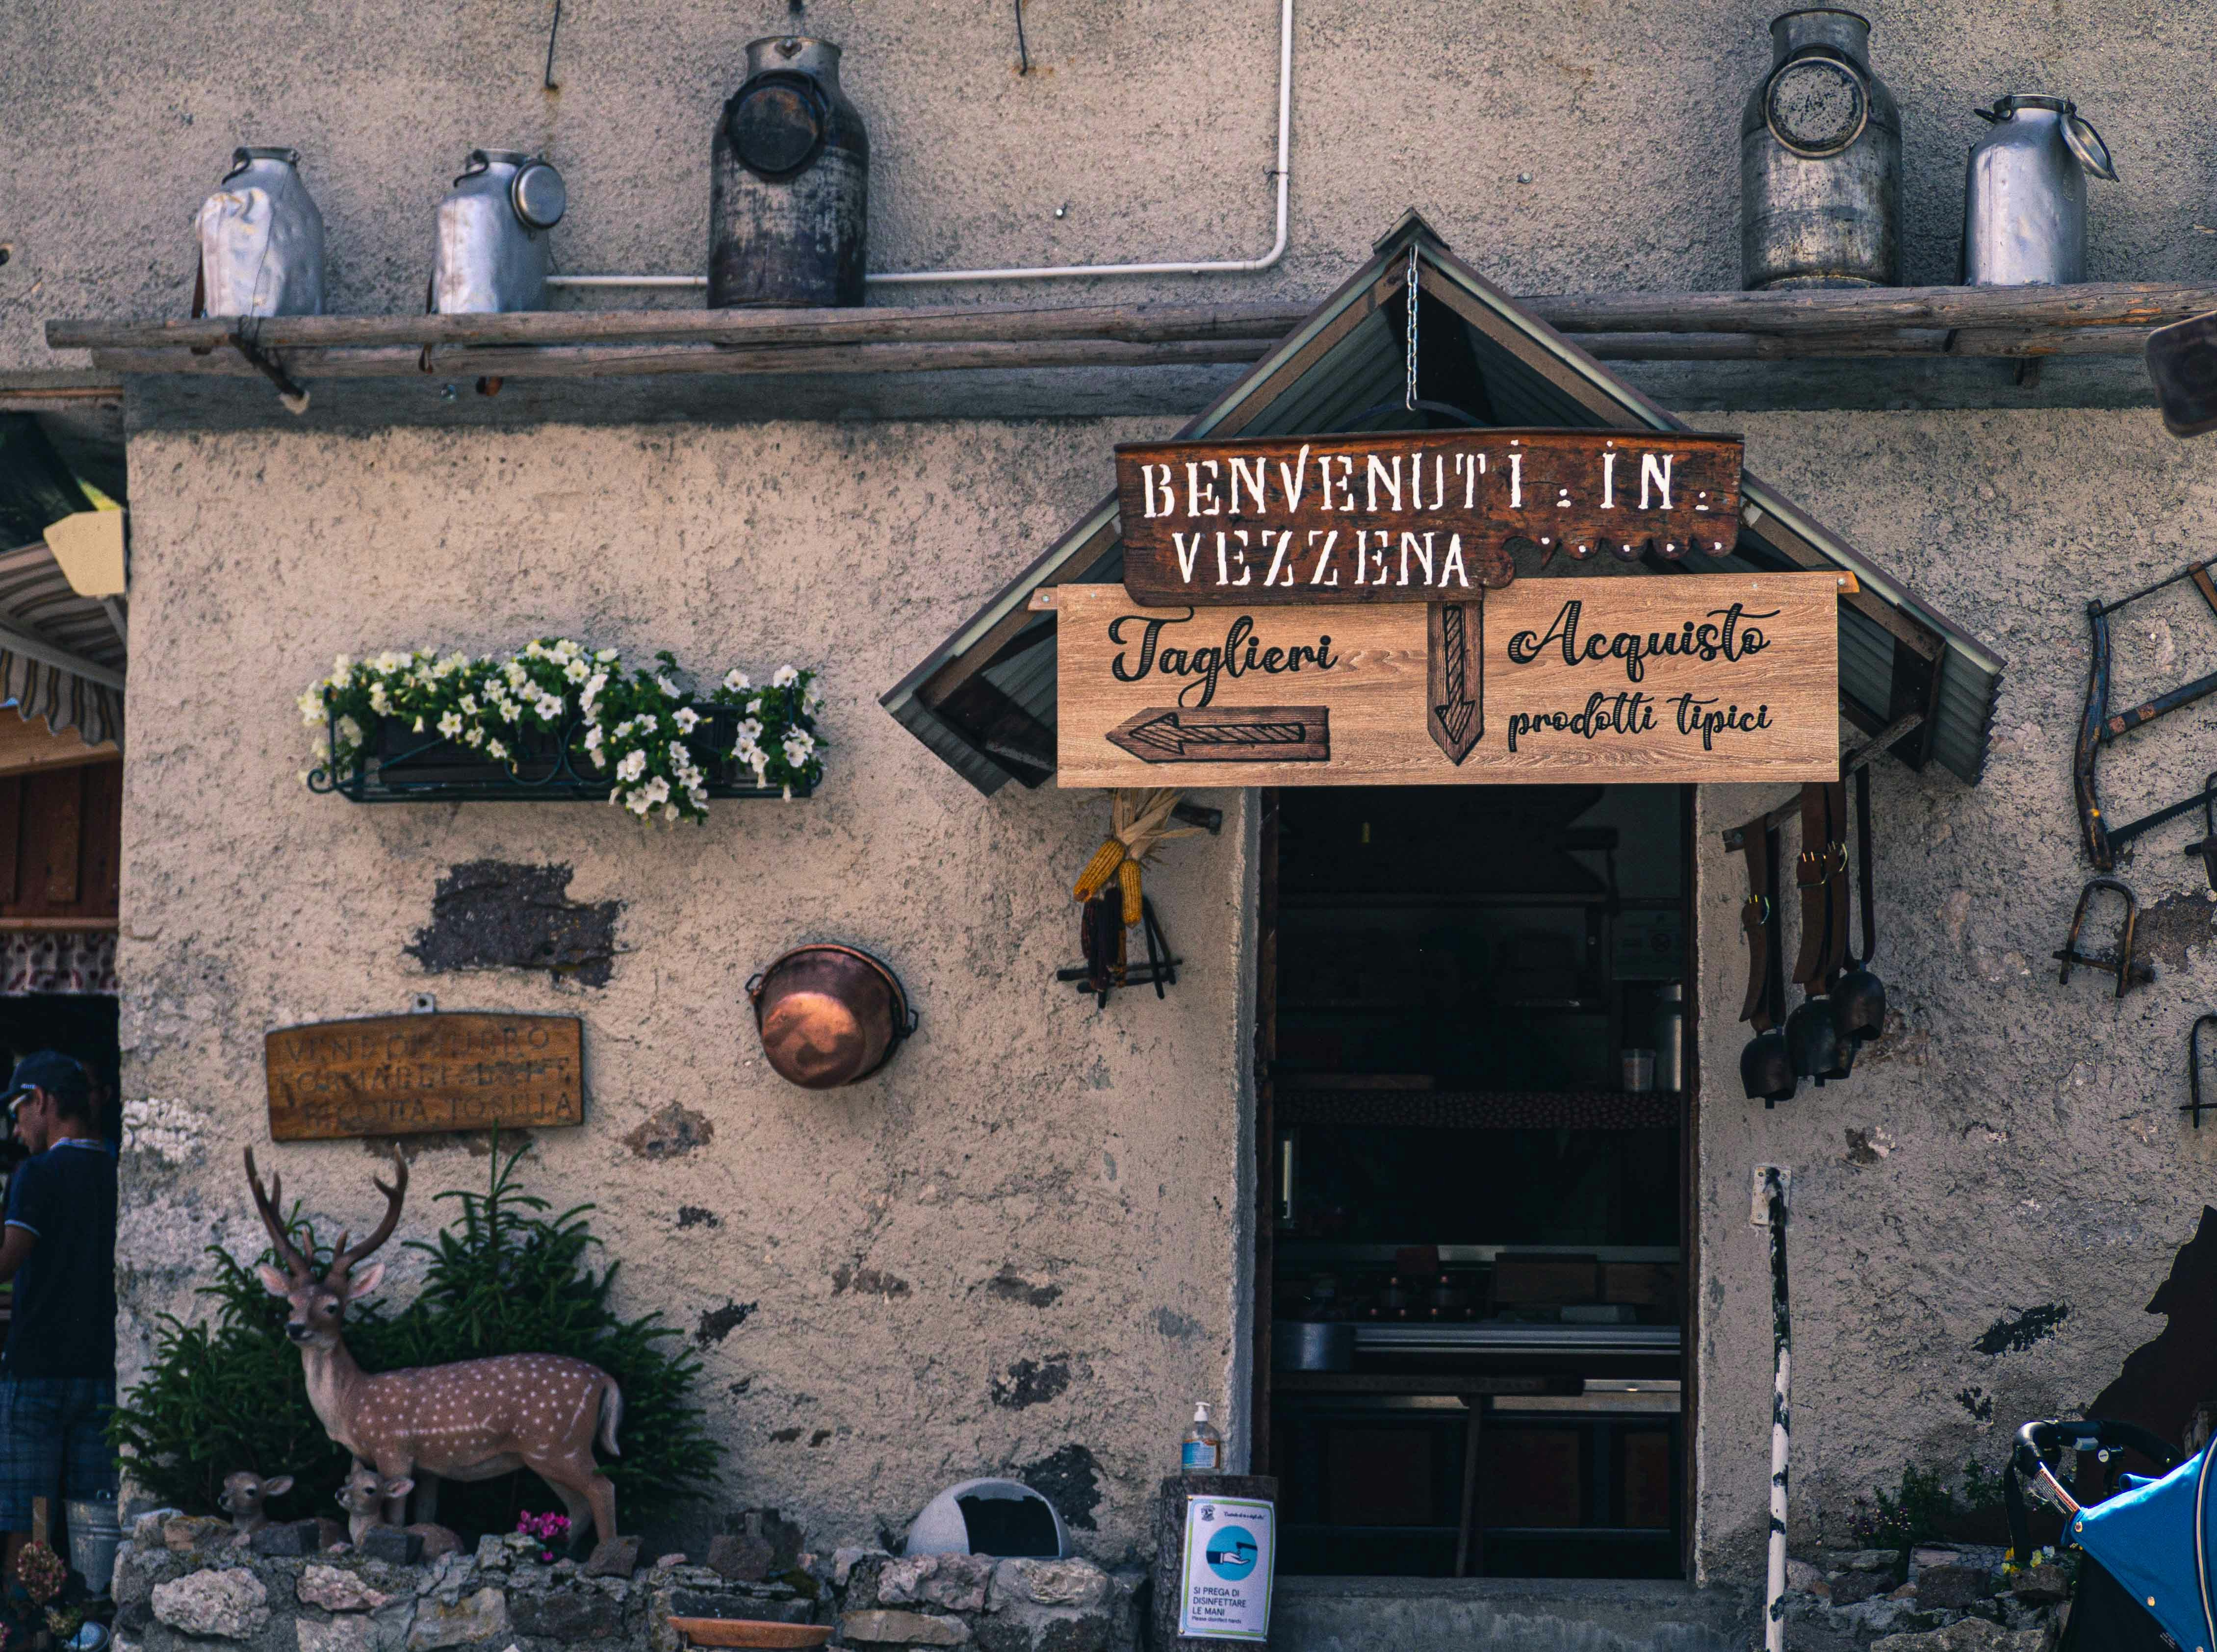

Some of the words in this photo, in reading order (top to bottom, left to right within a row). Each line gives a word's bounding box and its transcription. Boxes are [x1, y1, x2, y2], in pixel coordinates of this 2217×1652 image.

[1141, 440, 1521, 518] BENVENUTI
[1600, 440, 1674, 509] IN
[1172, 530, 1469, 587] VEZZENA
[1108, 606, 1339, 708] Taglieri
[1508, 600, 1780, 683] Acquisto
[1508, 691, 1657, 752] prodotti
[1666, 692, 1773, 751] tipici
[1193, 1597, 1247, 1608] DISINFETTARE
[1203, 1587, 1230, 1597] PREGA
